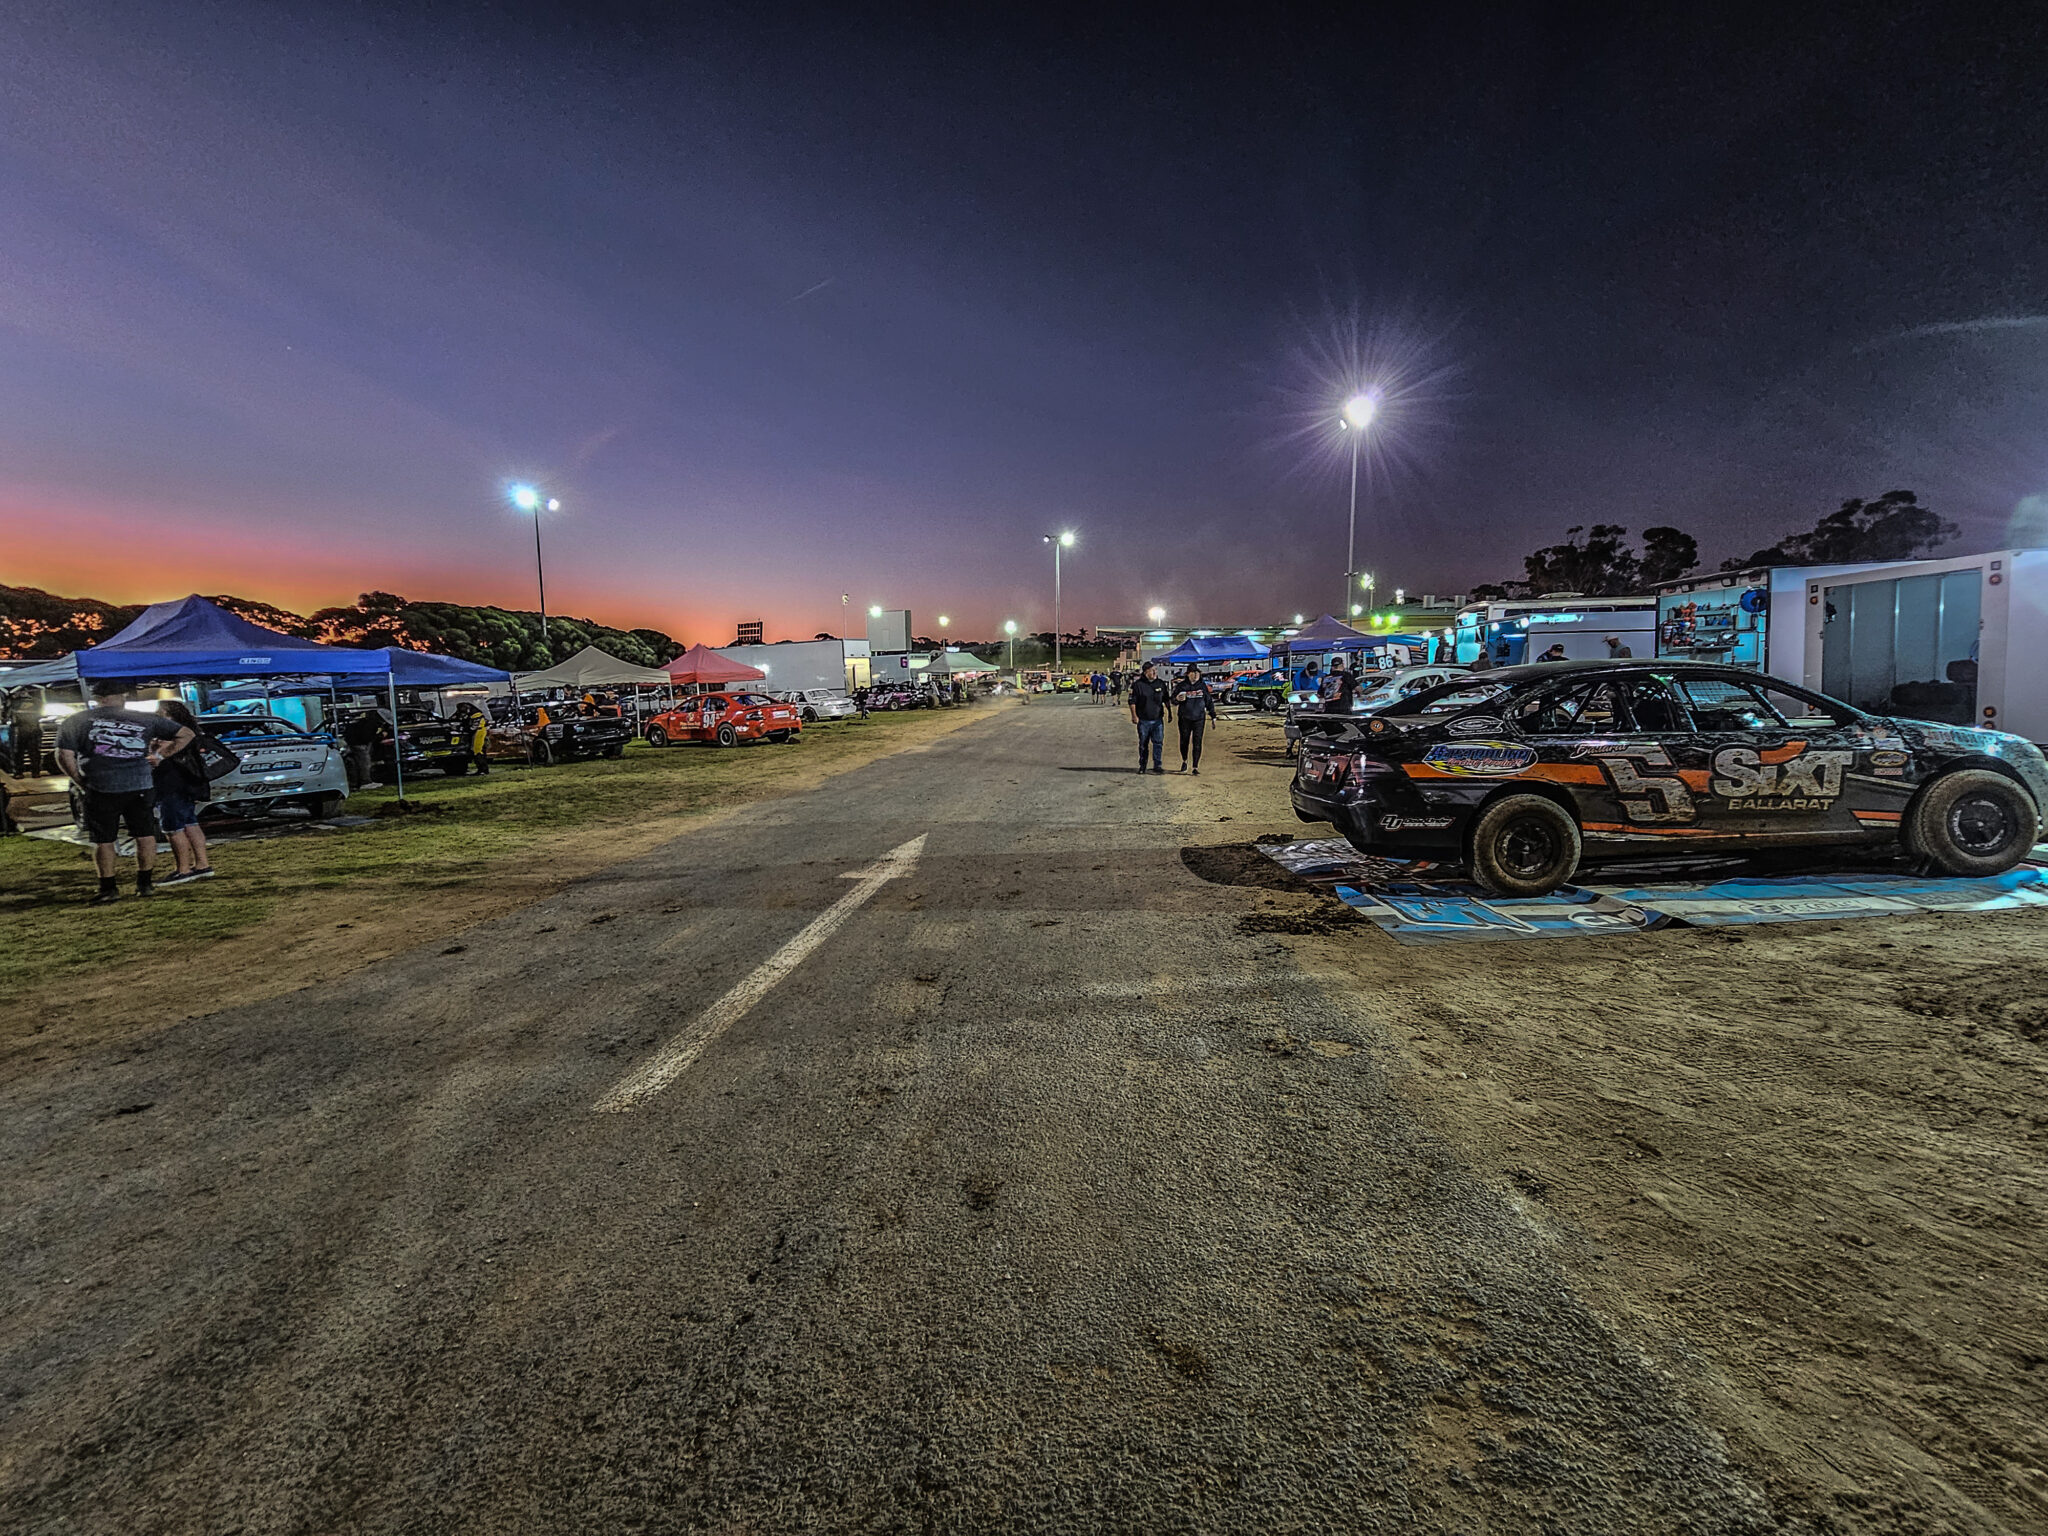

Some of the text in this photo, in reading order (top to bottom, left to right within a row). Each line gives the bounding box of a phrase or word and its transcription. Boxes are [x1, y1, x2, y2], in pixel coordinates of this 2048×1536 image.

[1378, 655, 1394, 670] 86
[875, 692, 893, 705] 37
[703, 713, 716, 729] 94
[1728, 799, 1834, 811] BALLARAT
